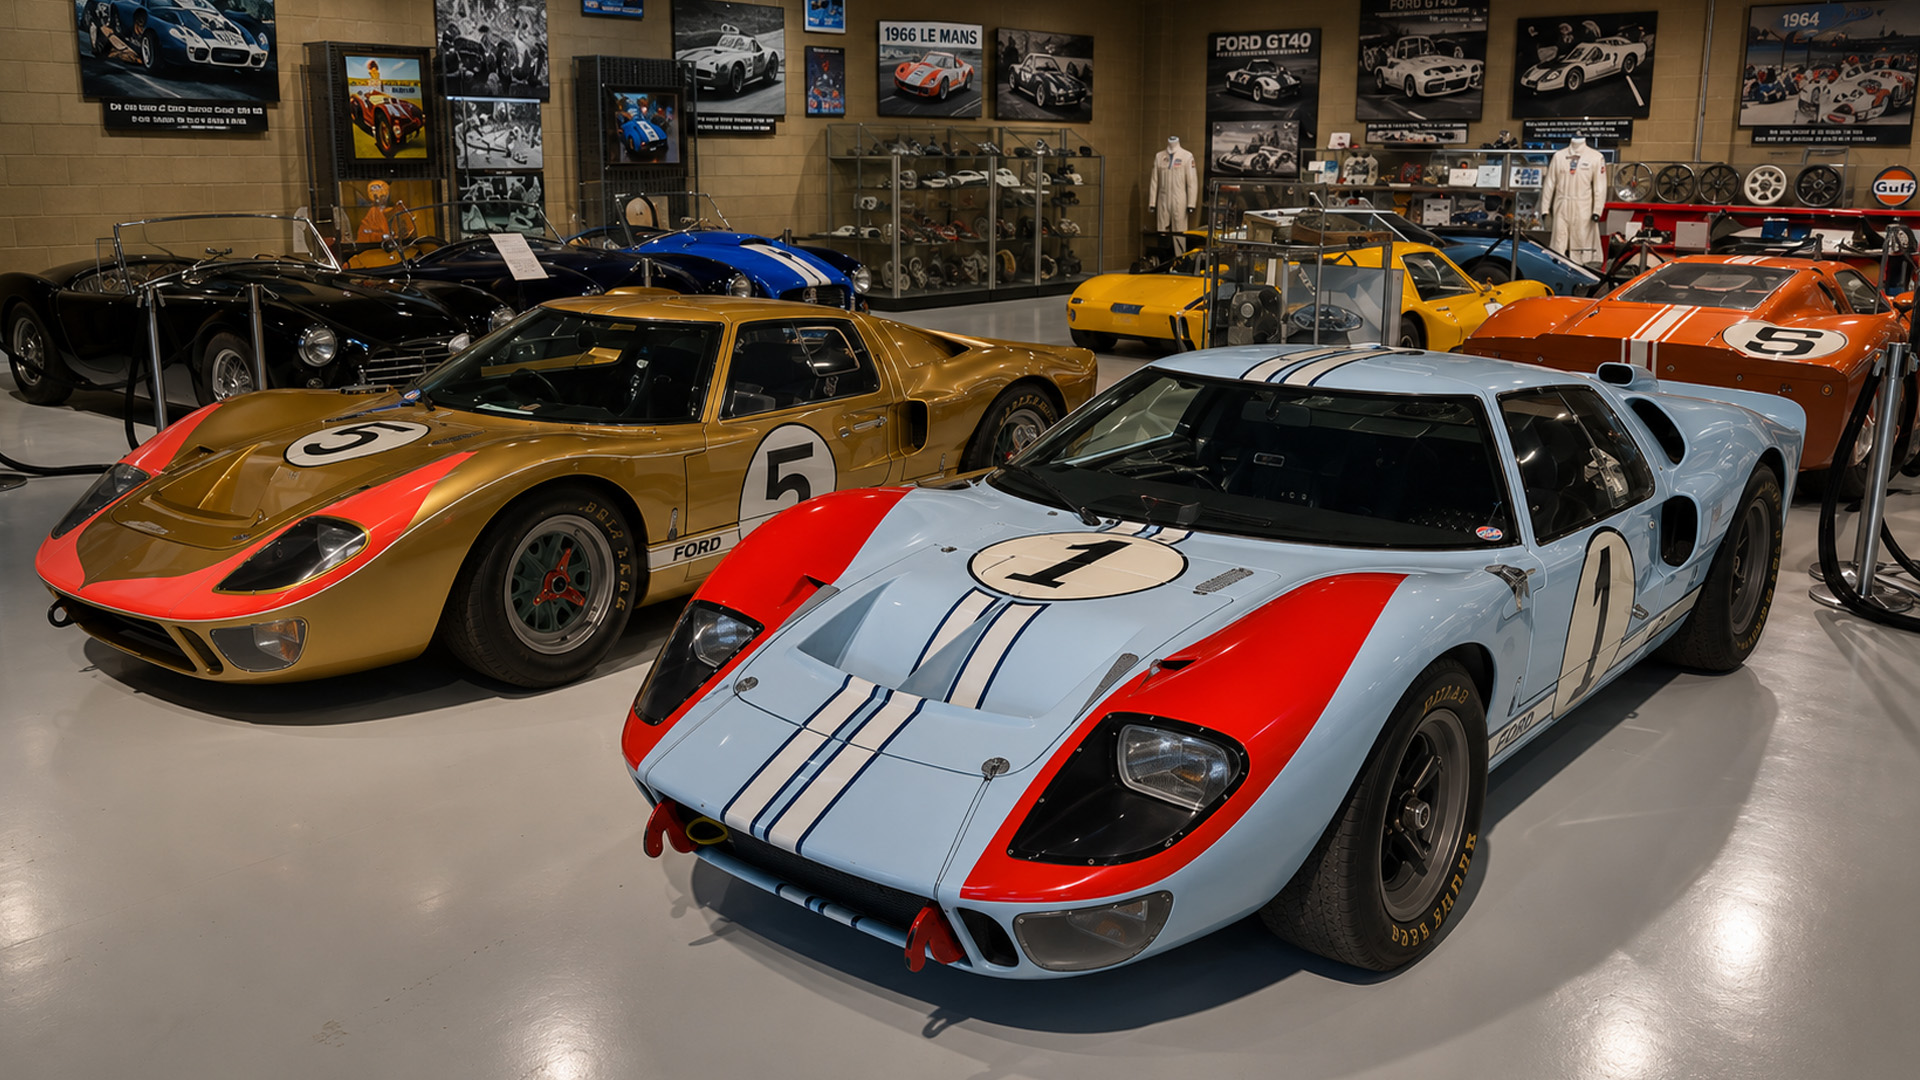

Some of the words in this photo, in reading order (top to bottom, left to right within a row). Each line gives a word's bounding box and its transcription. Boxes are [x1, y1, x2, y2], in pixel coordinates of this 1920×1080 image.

[1390, 0, 1421, 10] FORD
[1782, 11, 1820, 28] 1964
[885, 26, 917, 41] 1966
[920, 28, 936, 43] LE
[940, 28, 978, 45] MANS
[1216, 35, 1262, 51] FORD
[1266, 32, 1312, 49] GT40
[1875, 181, 1915, 193] Gulf
[1745, 326, 1824, 356] 5
[303, 422, 415, 456] 5
[765, 441, 814, 504] 5
[672, 536, 721, 562] FORD
[1005, 539, 1133, 589] 1
[1564, 545, 1611, 706] 1
[1494, 711, 1535, 755] FORD
